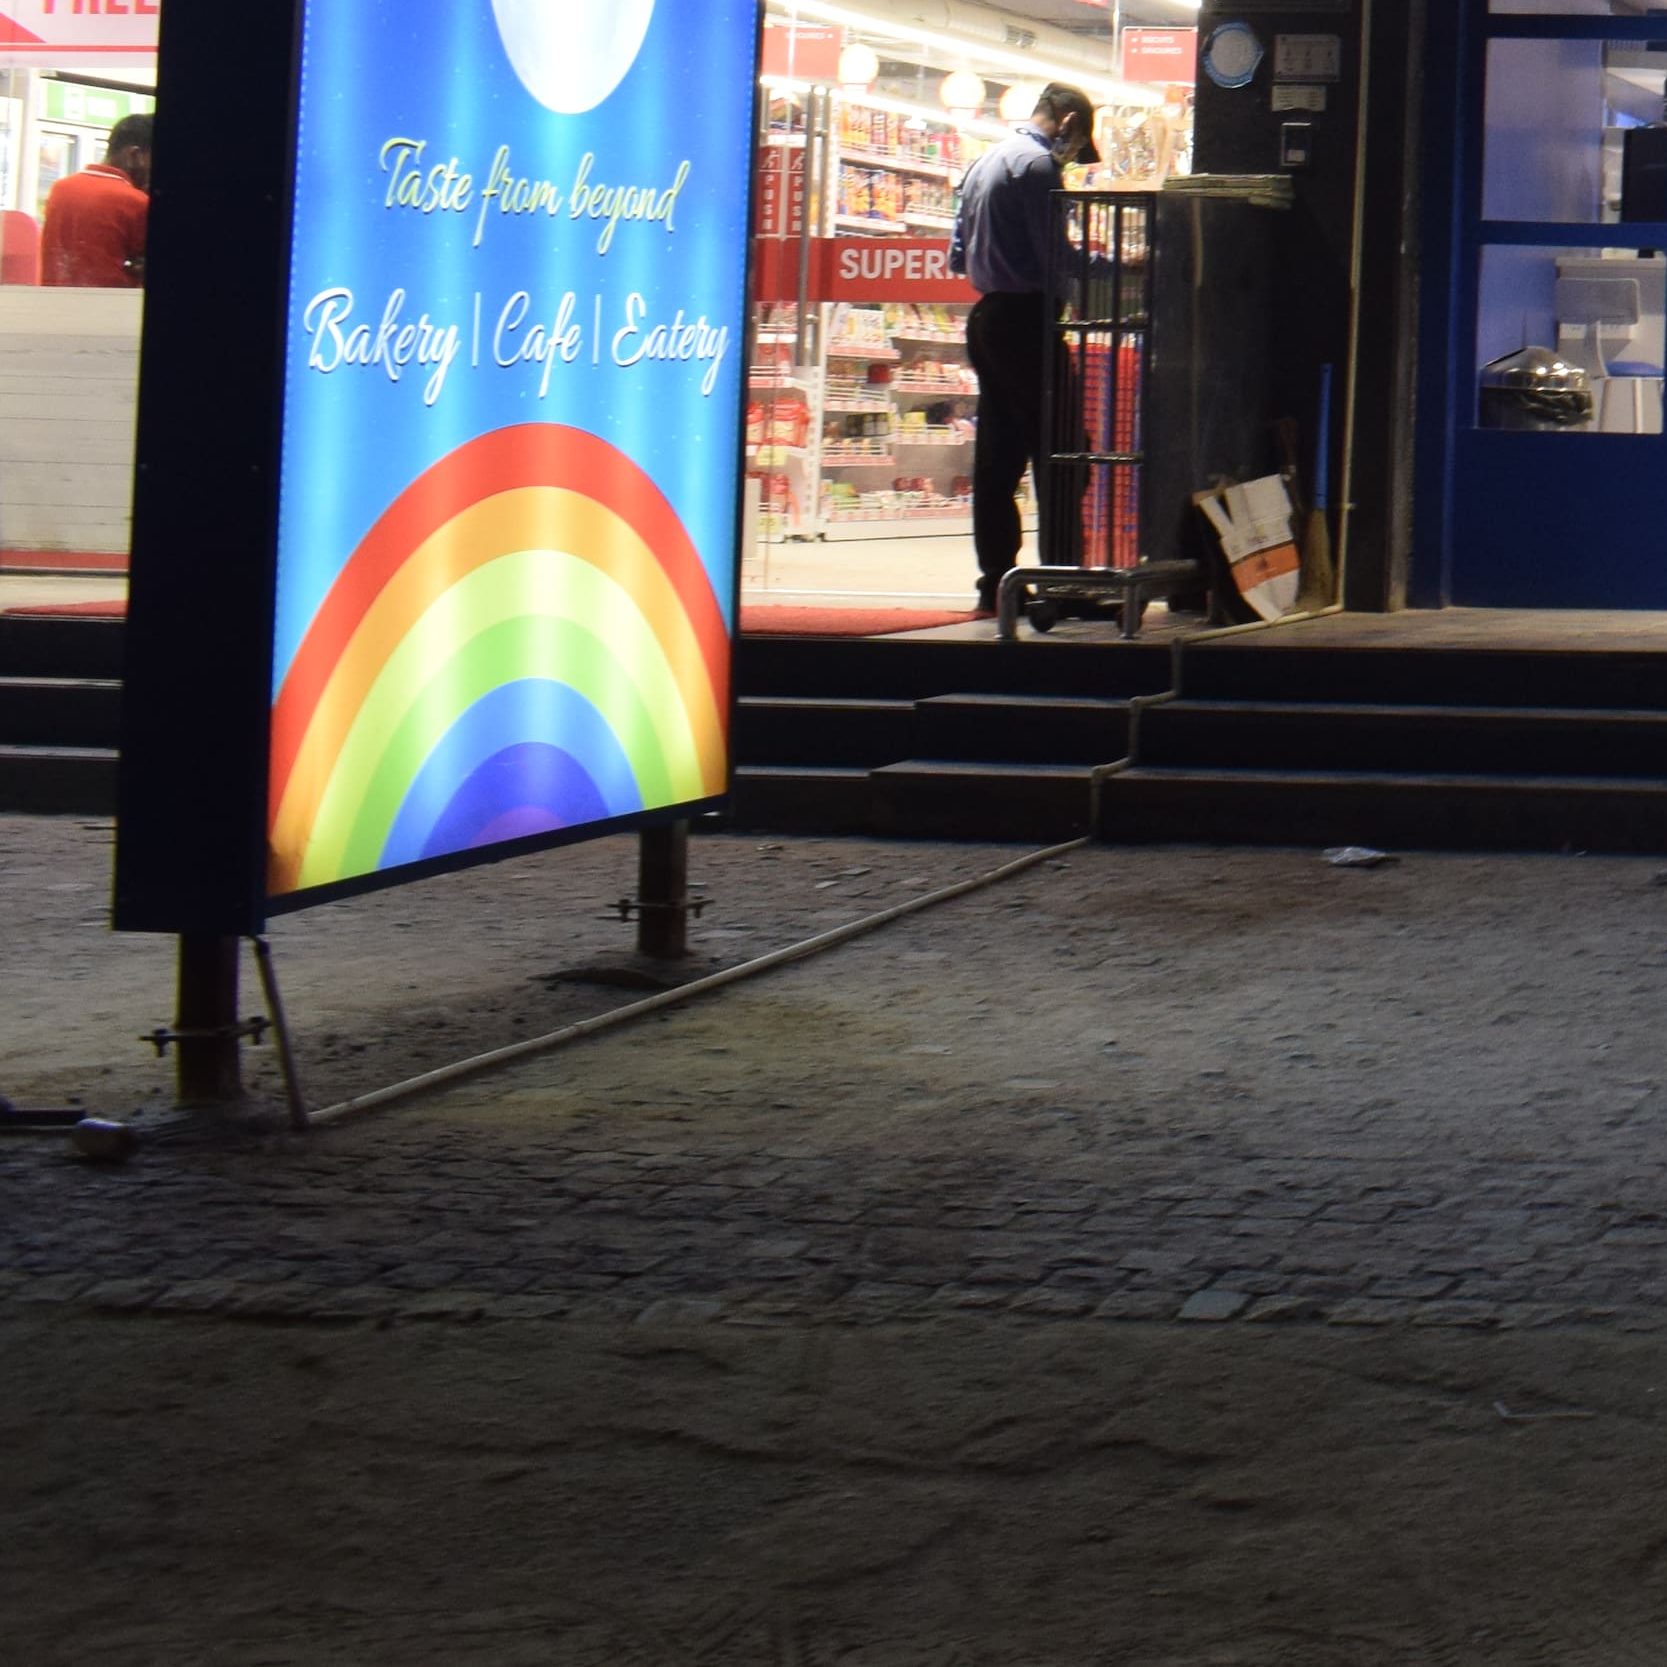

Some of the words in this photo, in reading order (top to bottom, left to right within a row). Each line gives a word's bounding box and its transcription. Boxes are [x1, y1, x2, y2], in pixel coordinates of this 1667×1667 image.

[380, 136, 473, 217] Taste
[472, 145, 563, 246] from
[570, 159, 693, 255] beyond
[839, 248, 967, 281] SUPER
[302, 285, 461, 407] Bakery
[492, 292, 583, 396] Cafe
[611, 290, 730, 396] Eatery
